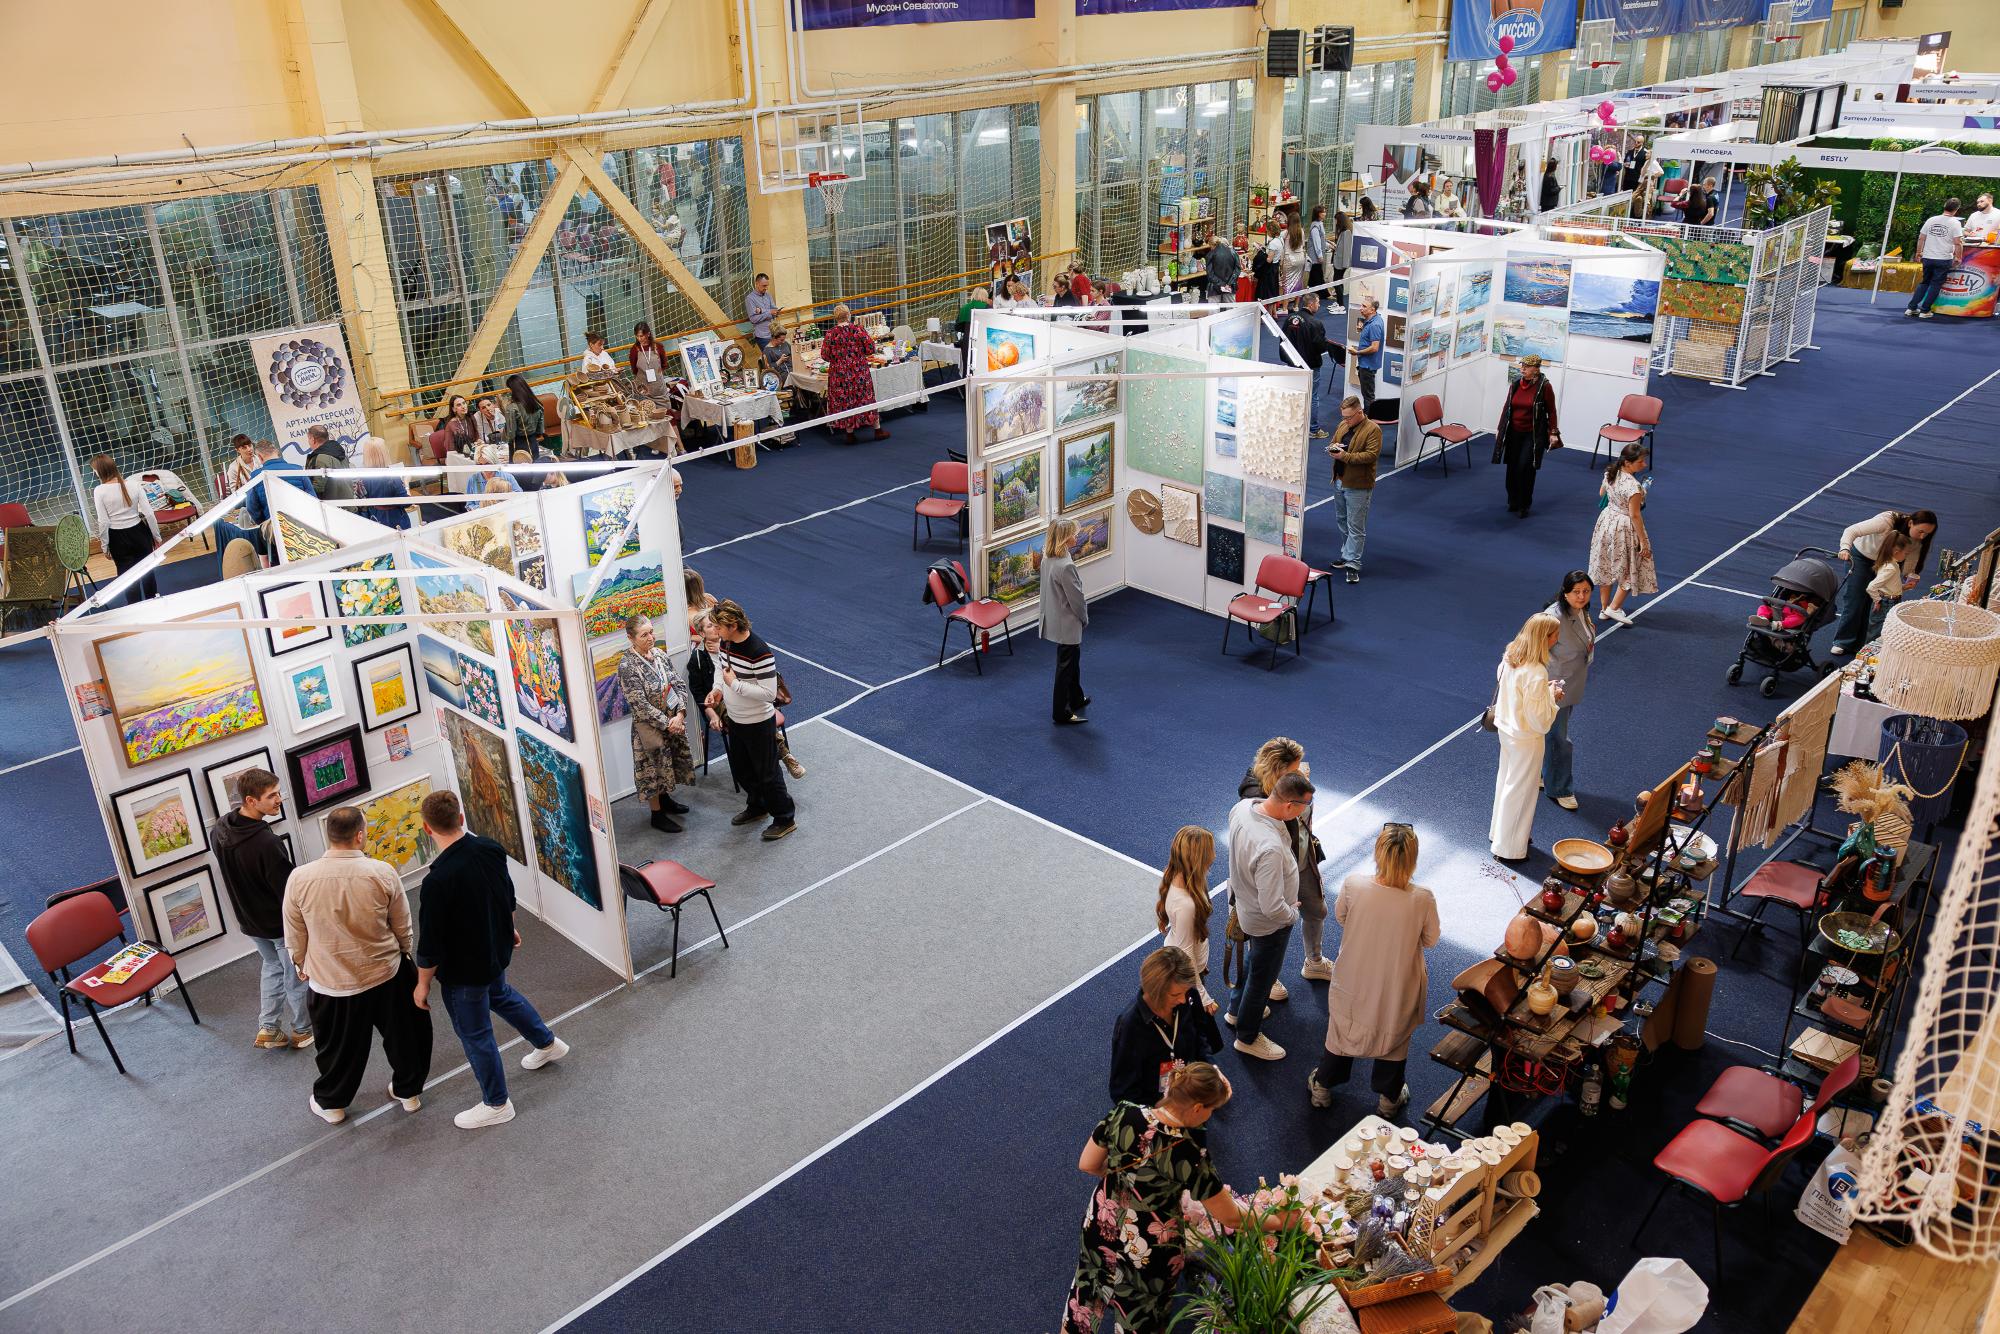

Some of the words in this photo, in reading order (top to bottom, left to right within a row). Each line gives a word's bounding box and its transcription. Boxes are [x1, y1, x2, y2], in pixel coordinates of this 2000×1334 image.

[866, 3, 902, 14] Муссон
[902, 1, 959, 11] Севастополь
[1498, 22, 1536, 39] МУССОН
[1690, 148, 1733, 156] АТМОСФЕРА
[1820, 155, 1849, 163] BESTLY
[1944, 274, 1979, 292] estly
[285, 407, 355, 429] АРТ-МАСТЕРСКАЯ
[1811, 1188, 1843, 1214] ПЕЧАТИ
